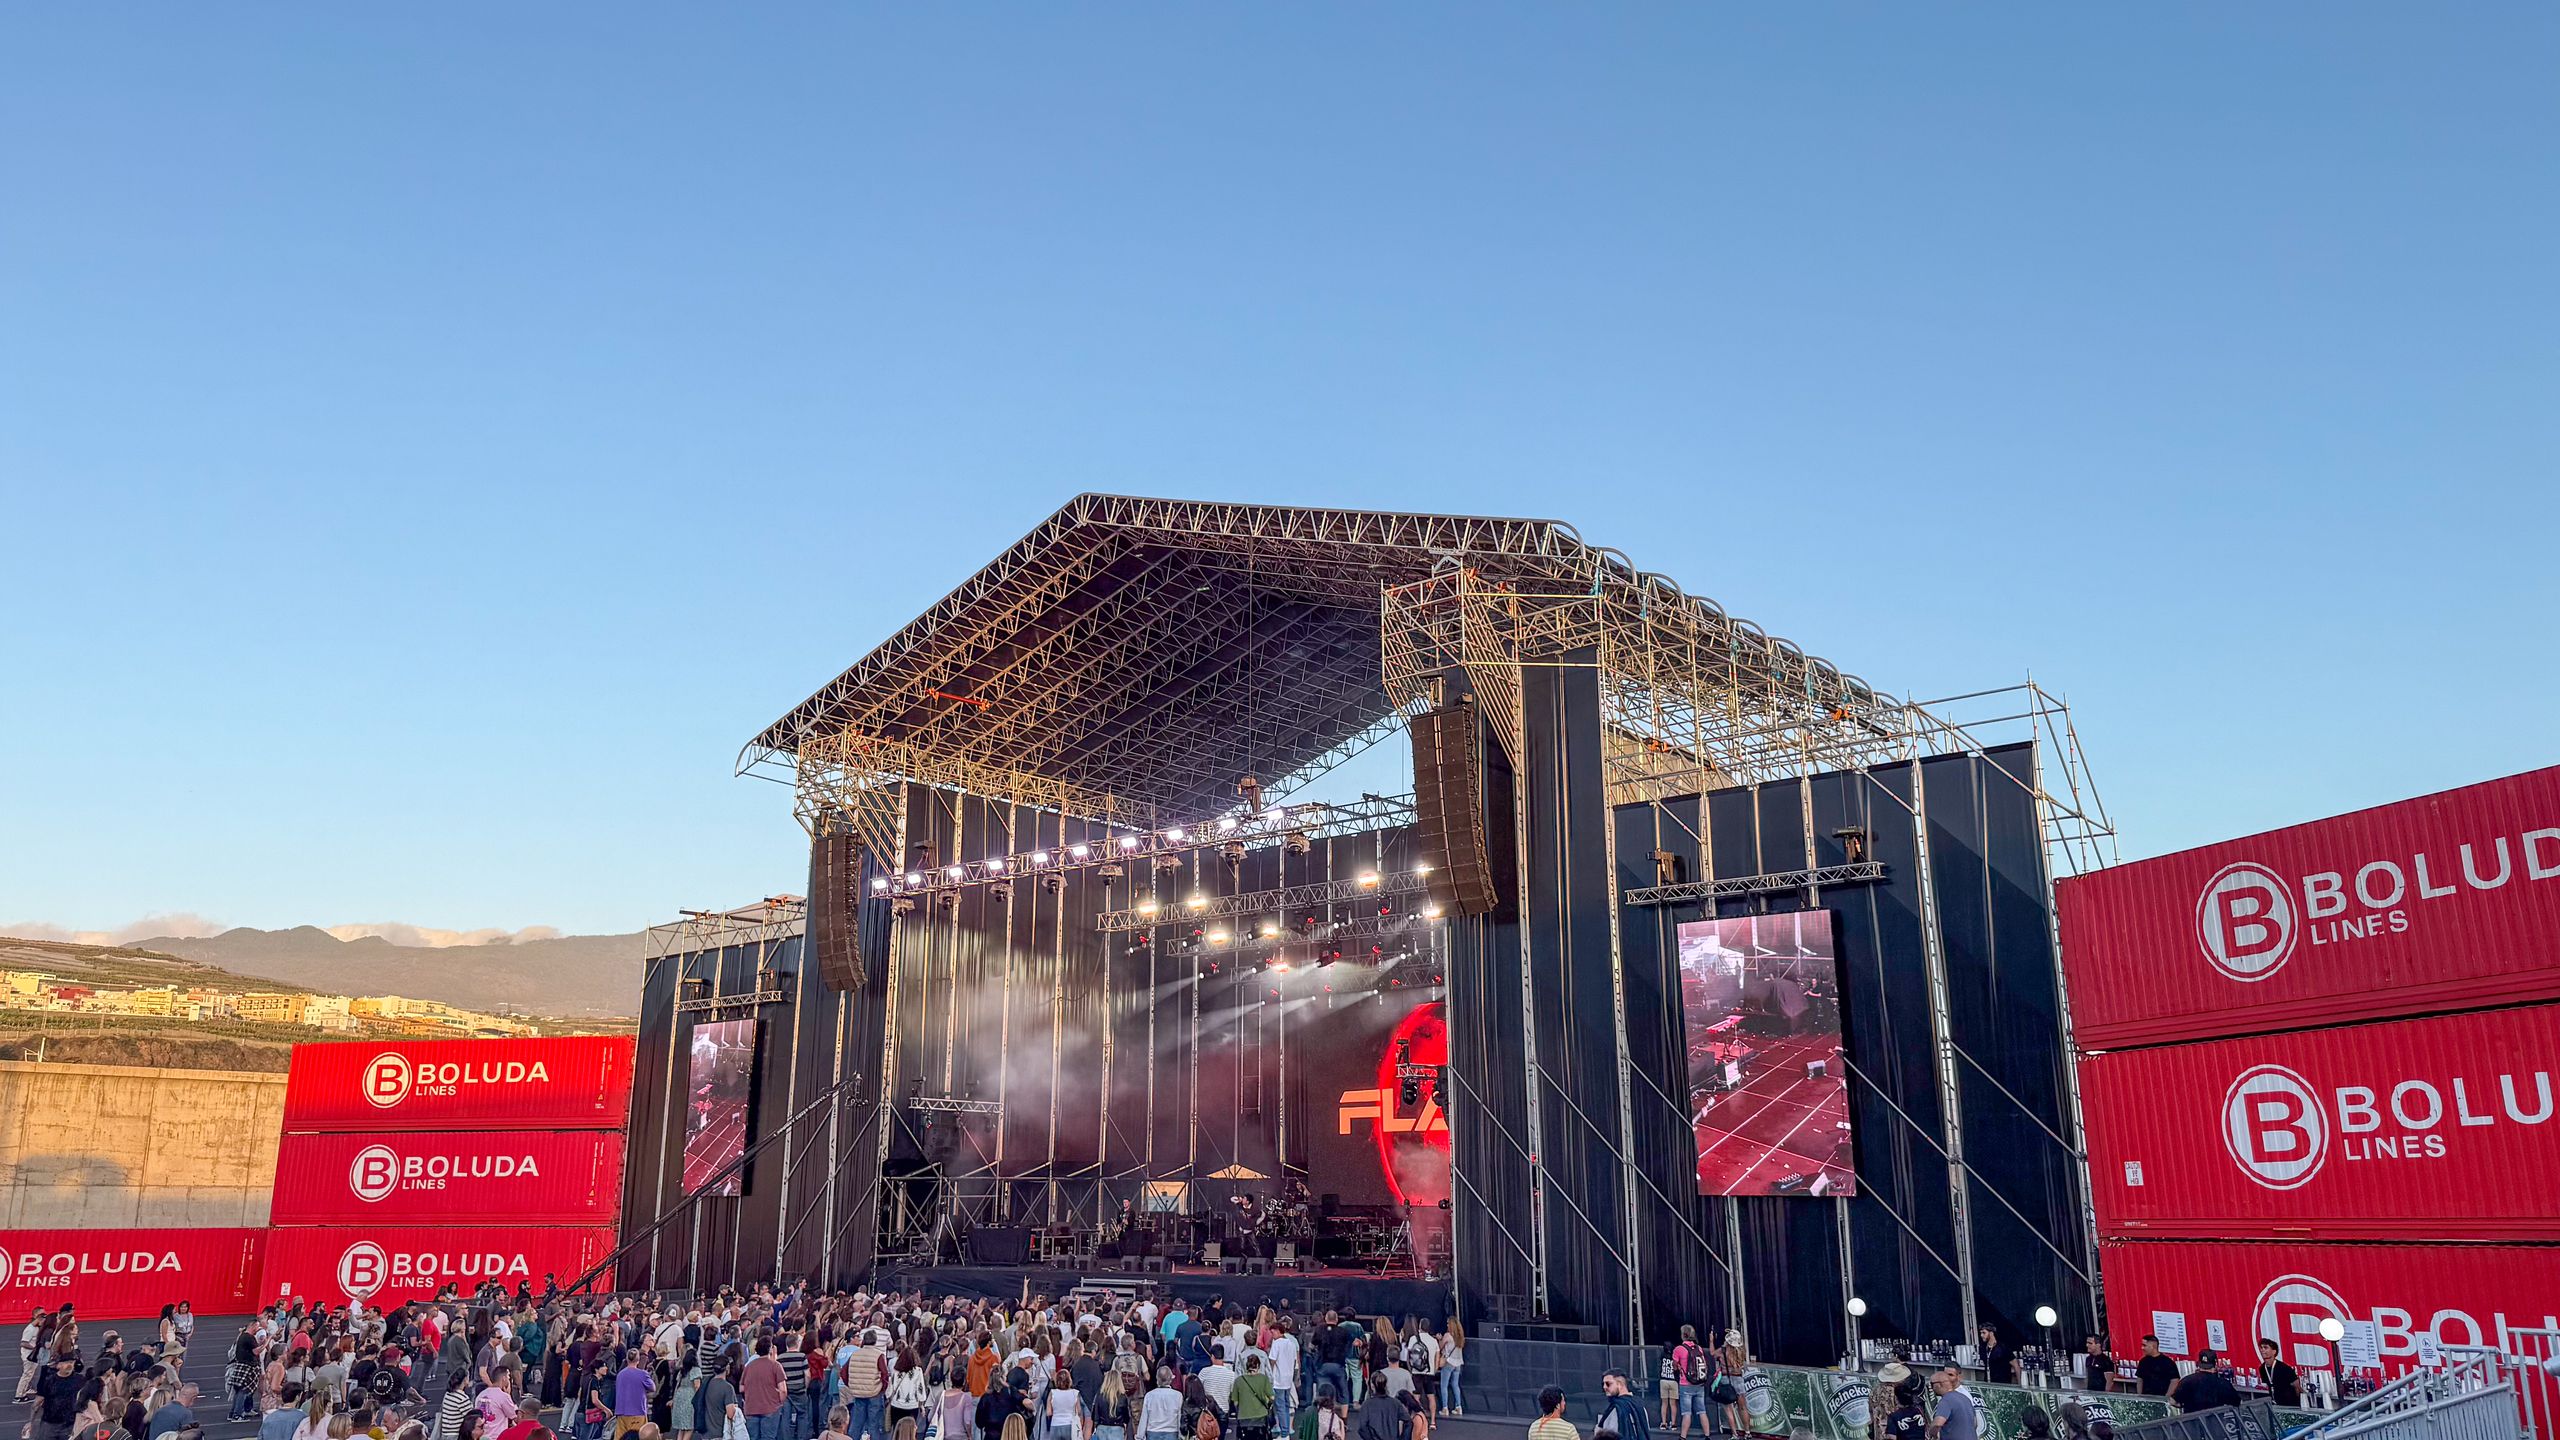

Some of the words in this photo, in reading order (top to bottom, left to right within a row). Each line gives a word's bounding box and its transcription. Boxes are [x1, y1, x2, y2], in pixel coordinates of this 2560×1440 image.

[2303, 828, 2560, 920] BOLUD
[2217, 885, 2284, 959] B
[2310, 909, 2409, 945] LINES
[418, 1062, 550, 1085] BOLUDA
[416, 1085, 457, 1096] LINES
[2336, 1072, 2554, 1133] BOLU
[2243, 1091, 2311, 1164] B
[2343, 1135, 2447, 1161] LINES
[404, 1155, 540, 1178] BOLUDA
[403, 1179, 446, 1190] LINES
[18, 1252, 182, 1275] BOLUDA
[393, 1253, 530, 1276] BOLUDA
[16, 1276, 71, 1288] LINES
[391, 1277, 434, 1288] LINES
